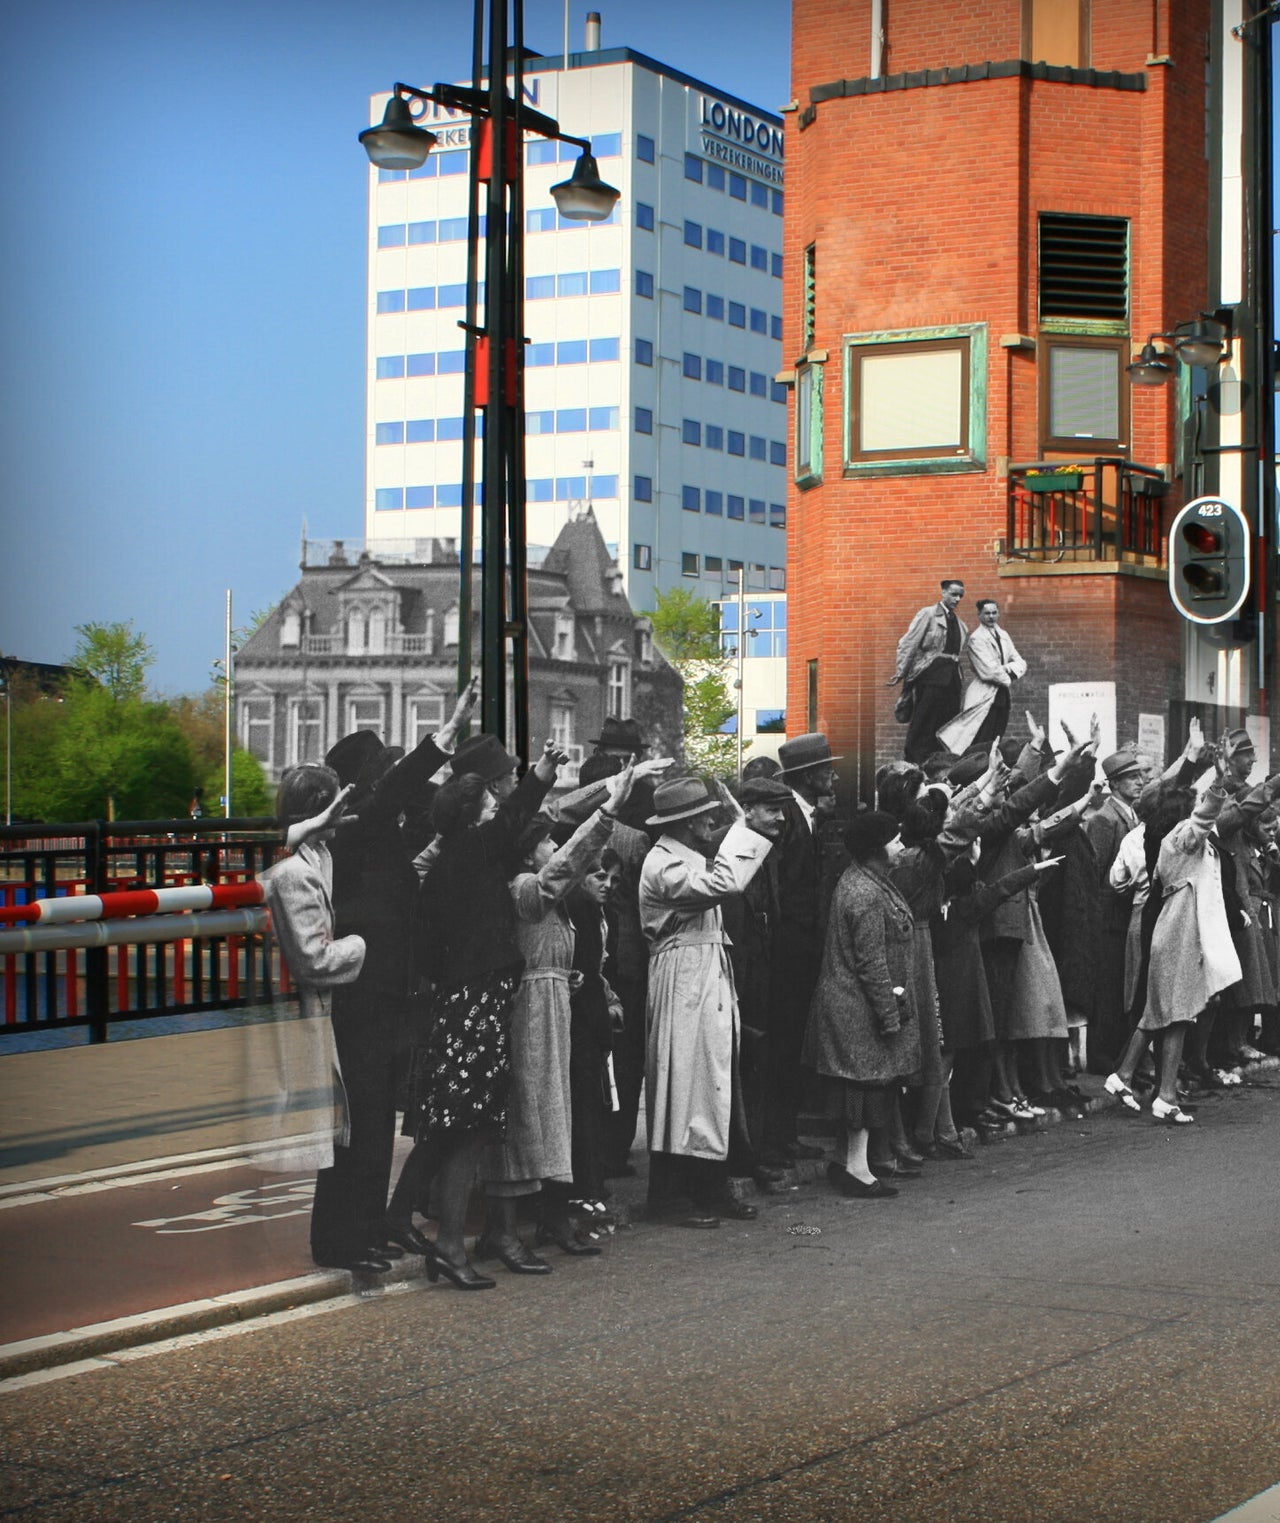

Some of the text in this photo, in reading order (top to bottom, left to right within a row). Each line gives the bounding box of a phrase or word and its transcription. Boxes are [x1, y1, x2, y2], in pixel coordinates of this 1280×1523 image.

[700, 95, 784, 157] LONDON
[702, 135, 784, 184] VERZEKERINGEN
[1198, 504, 1223, 517] 423
